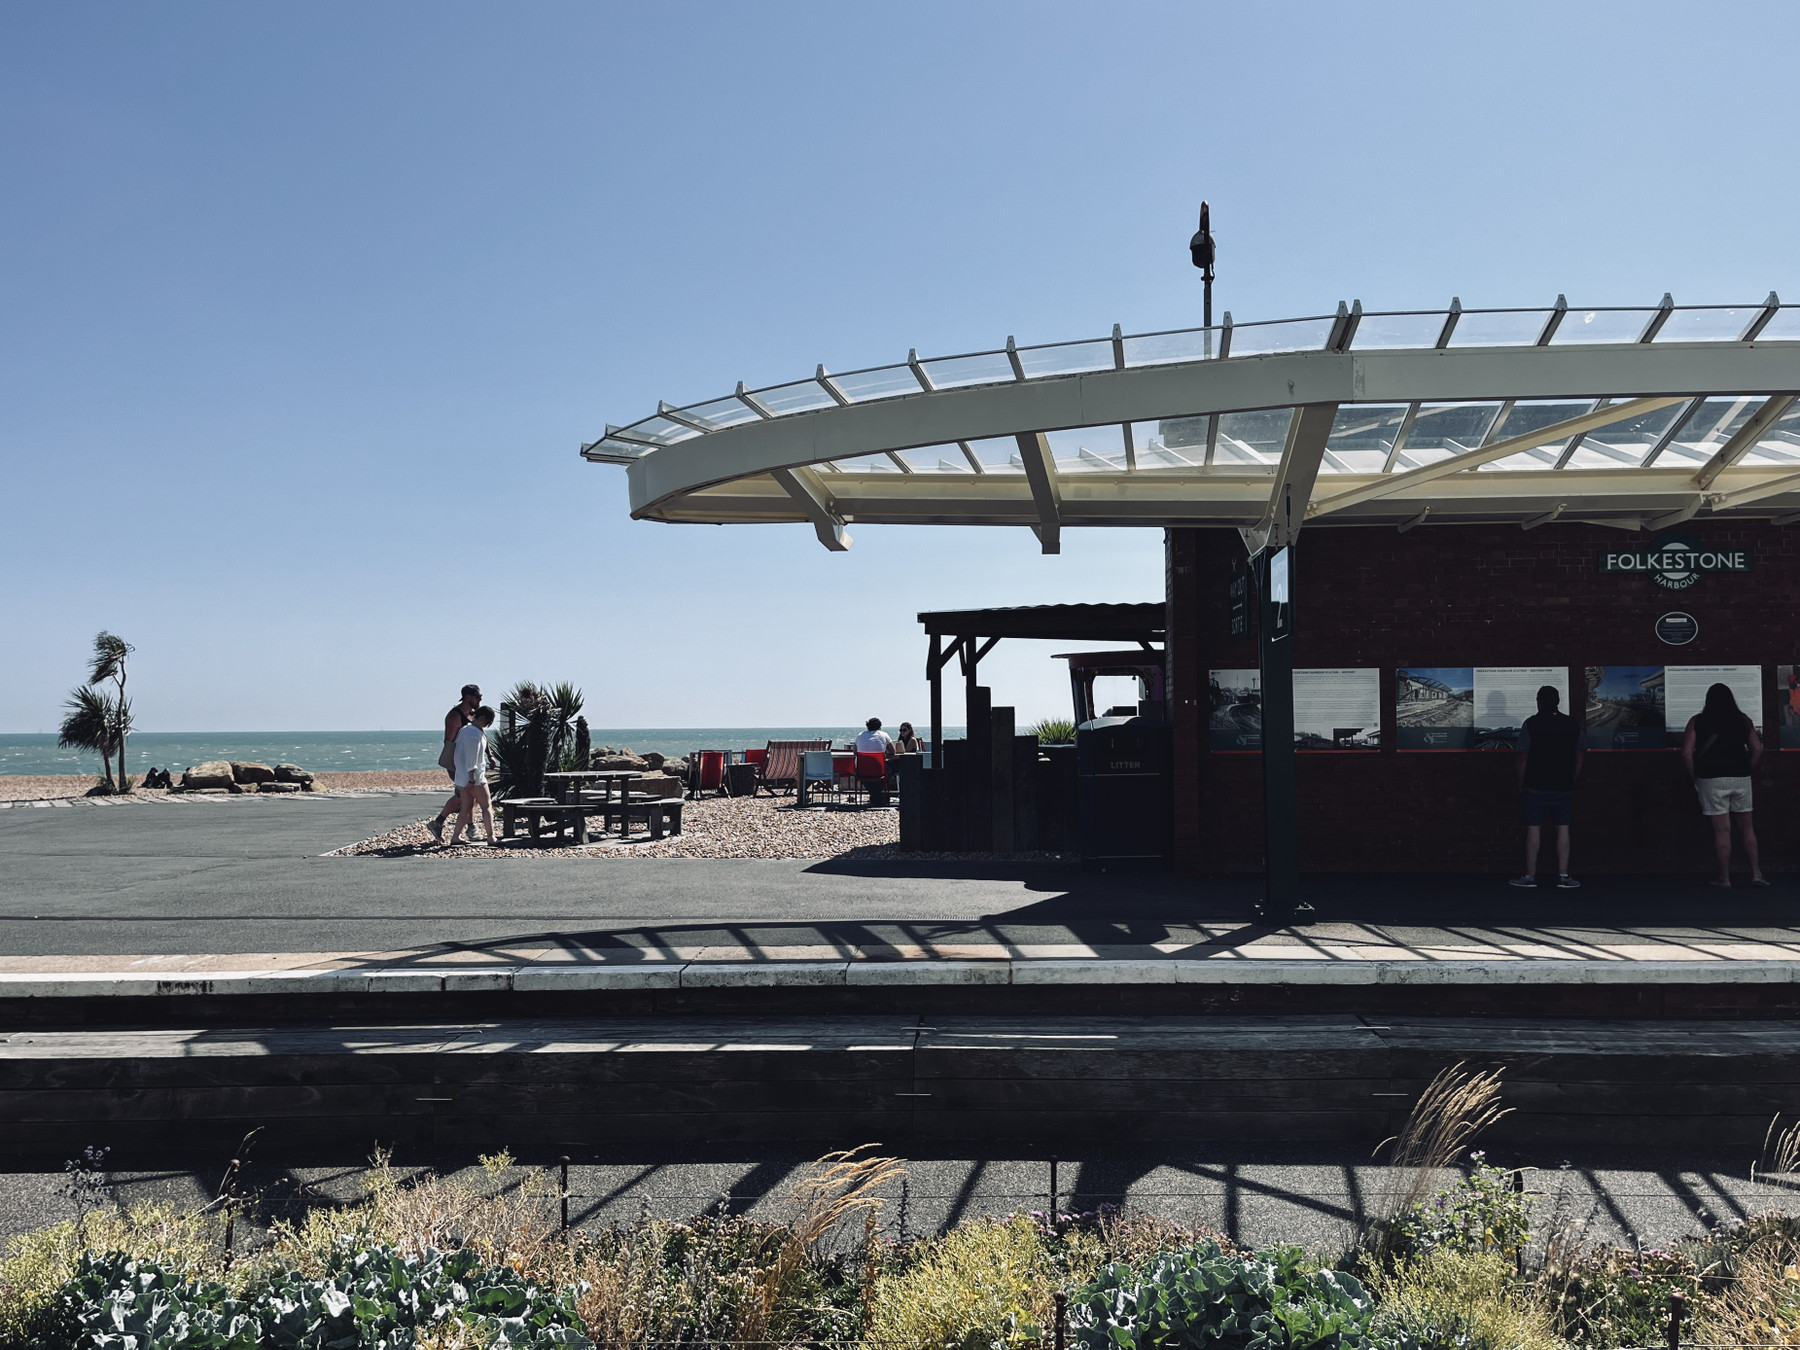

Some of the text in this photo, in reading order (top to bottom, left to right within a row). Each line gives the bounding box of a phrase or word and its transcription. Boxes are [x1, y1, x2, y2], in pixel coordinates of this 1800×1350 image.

[1606, 552, 1745, 570] FOLKESTONE
[1653, 572, 1701, 589] HARBOUR
[1277, 583, 1283, 628] 2
[1110, 761, 1141, 769] LITTER
